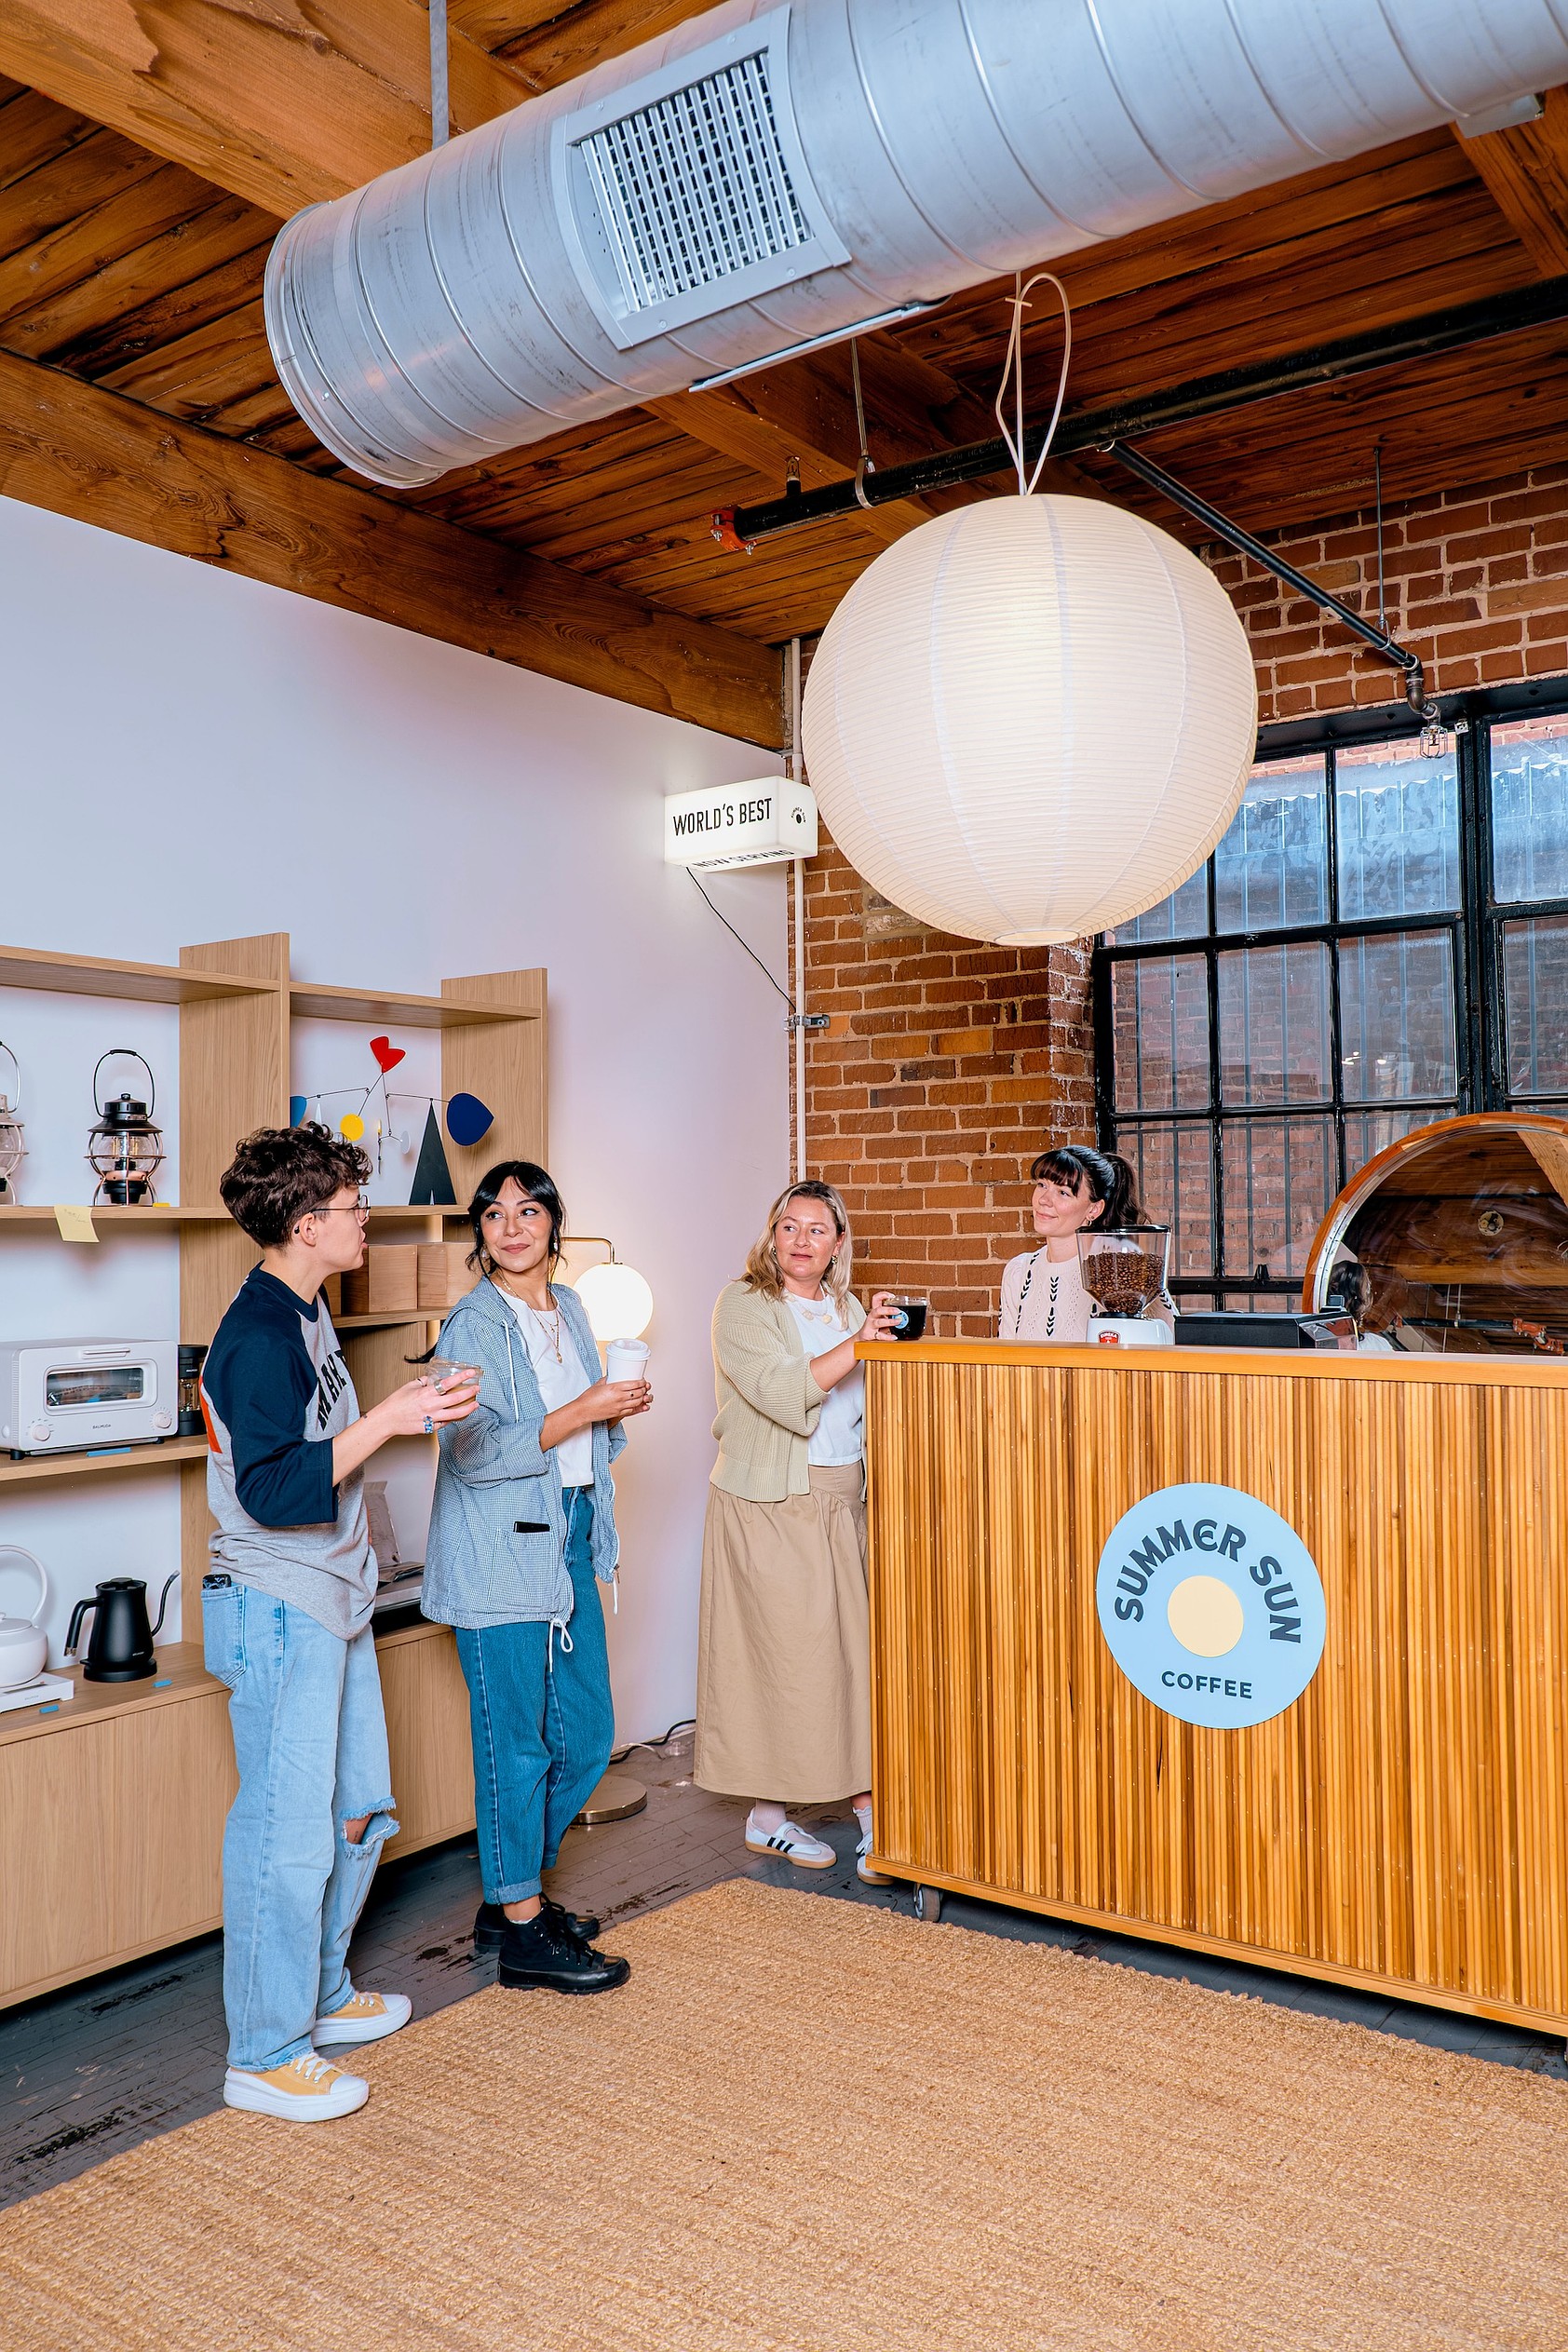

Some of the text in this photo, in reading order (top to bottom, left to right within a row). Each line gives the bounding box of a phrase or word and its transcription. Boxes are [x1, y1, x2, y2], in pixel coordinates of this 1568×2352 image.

[673, 798, 772, 836] WORLD'S BEST
[692, 849, 795, 868] NOW SERVING
[1115, 1519, 1302, 1643] SUMMER SUN
[1161, 1670, 1252, 1699] COFFEE
